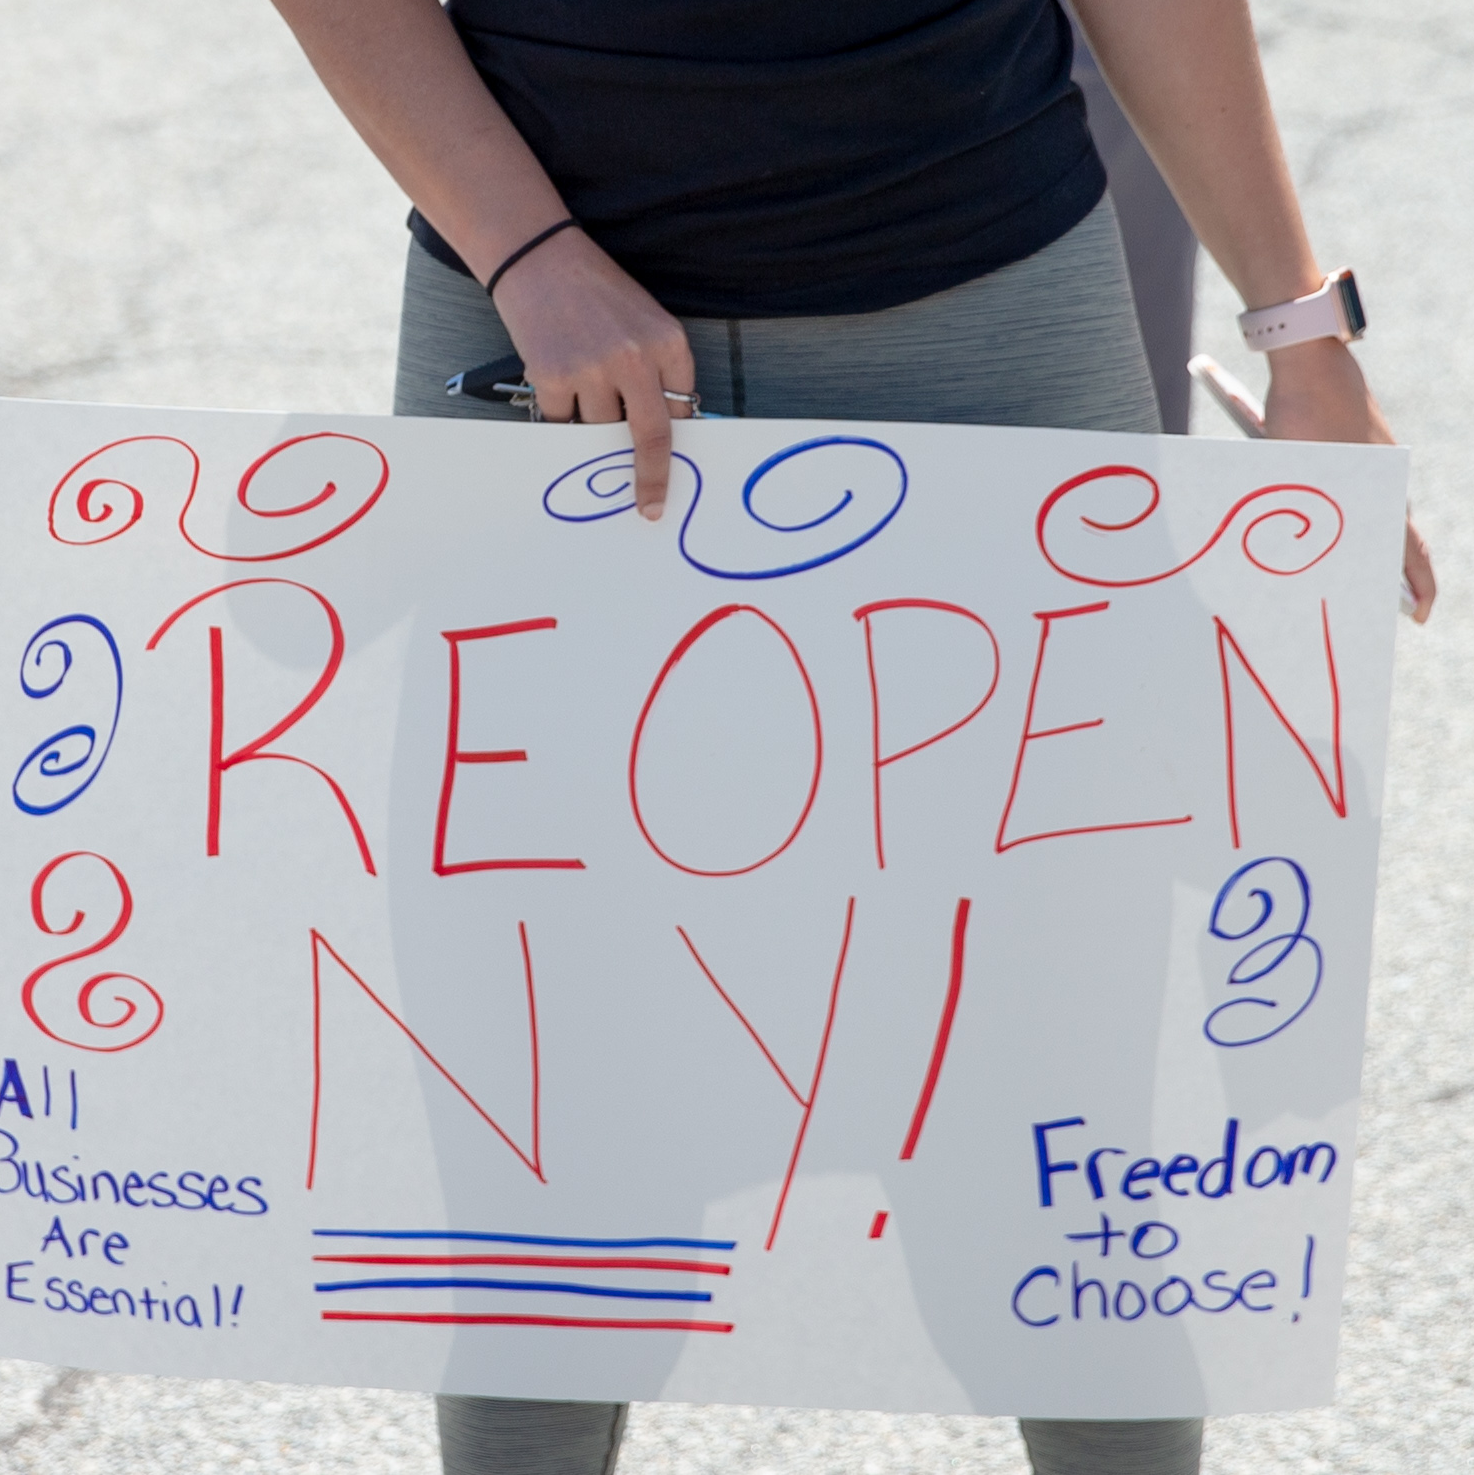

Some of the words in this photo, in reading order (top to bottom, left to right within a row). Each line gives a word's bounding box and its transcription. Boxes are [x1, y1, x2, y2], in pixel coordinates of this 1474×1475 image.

[146, 577, 1347, 877] REOPEN
[306, 896, 972, 1252] NY!
[1032, 1116, 1337, 1208] Freedom
[42, 1216, 130, 1266] Are
[1065, 1212, 1178, 1259] to
[6, 1261, 245, 1329] Essential!
